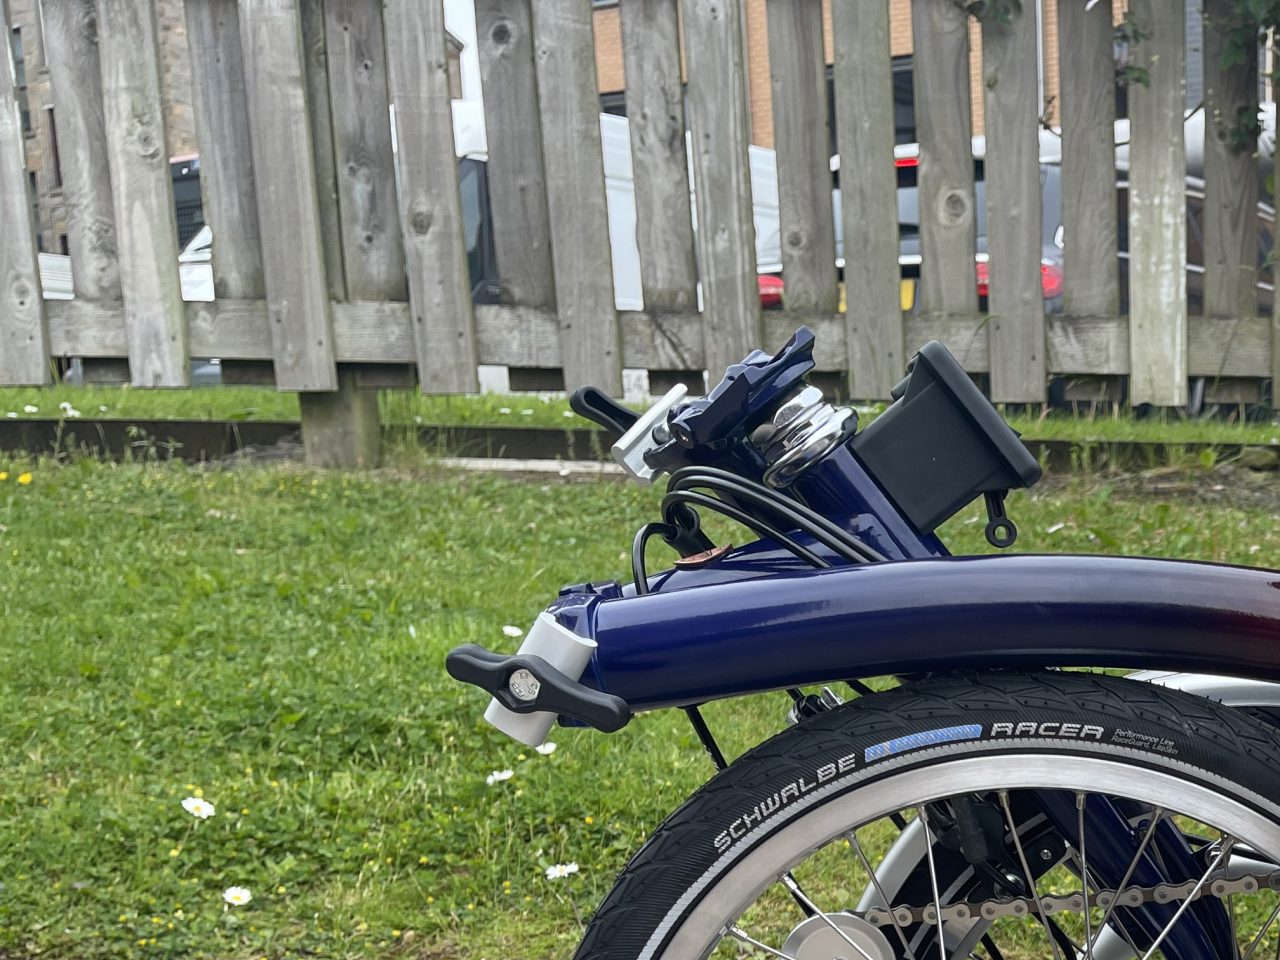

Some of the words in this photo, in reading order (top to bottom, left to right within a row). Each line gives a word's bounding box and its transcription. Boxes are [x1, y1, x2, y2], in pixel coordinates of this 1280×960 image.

[1114, 728, 1159, 743] Performance
[713, 753, 856, 853] SCHWALBE
[990, 722, 1104, 740] RACER
